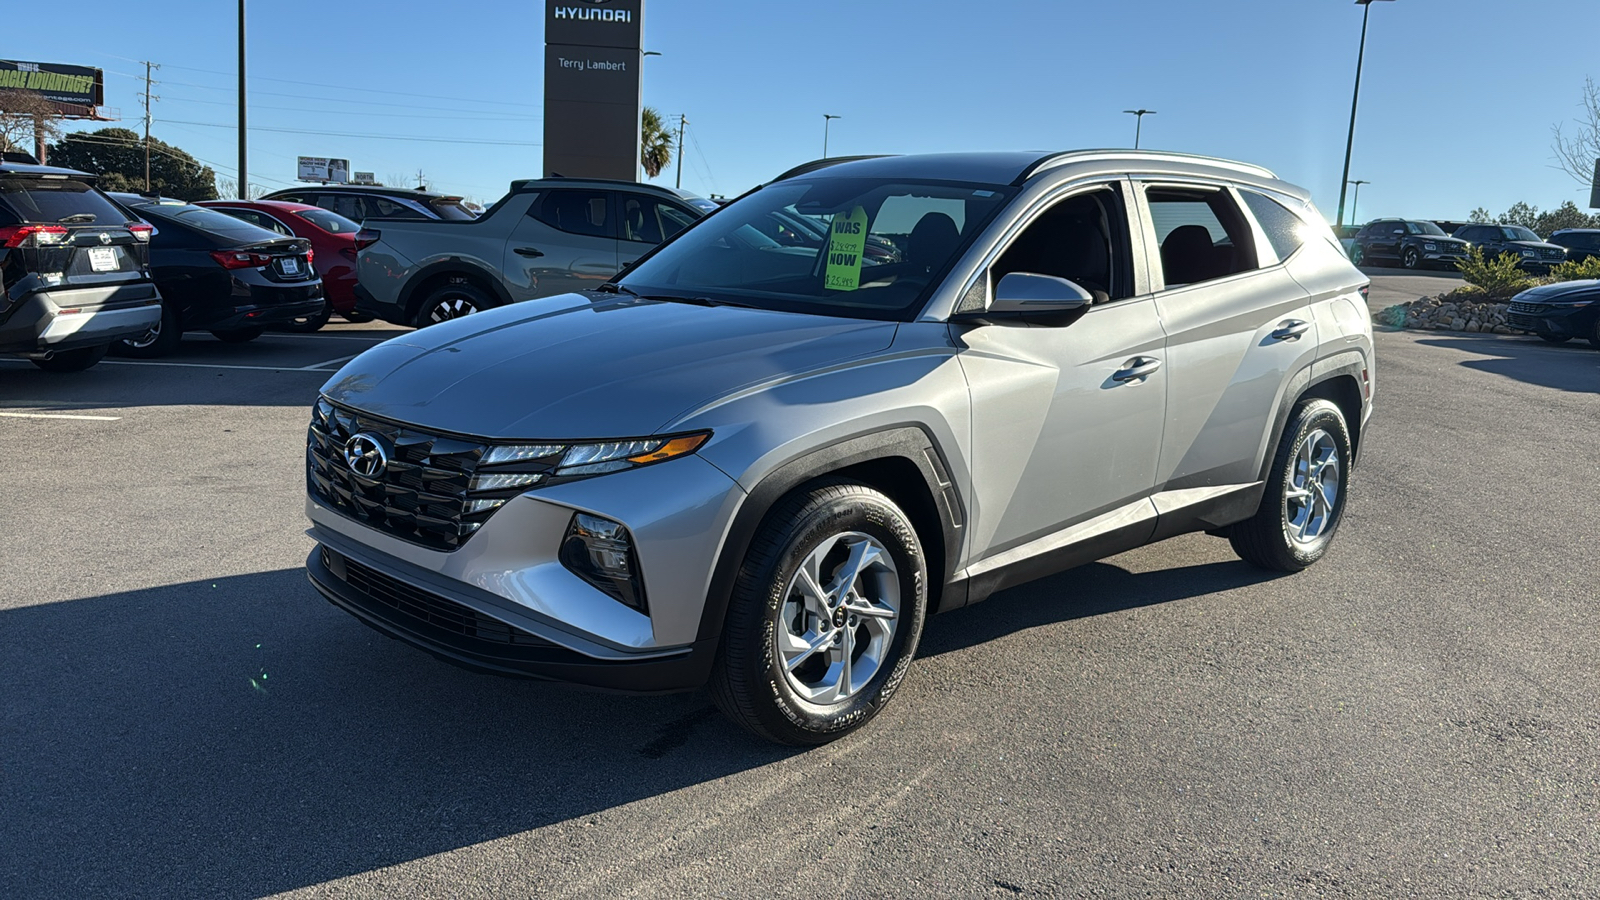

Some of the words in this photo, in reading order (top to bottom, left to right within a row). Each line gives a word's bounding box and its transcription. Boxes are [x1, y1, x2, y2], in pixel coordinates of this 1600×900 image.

[555, 6, 631, 23] HYUNDAI
[558, 58, 584, 71] Terry
[587, 59, 626, 71] Lambert
[0, 69, 27, 89] ACLE
[27, 72, 94, 94] ADVANTAGE?
[835, 222, 861, 235] WAS
[829, 253, 857, 267] NOW
